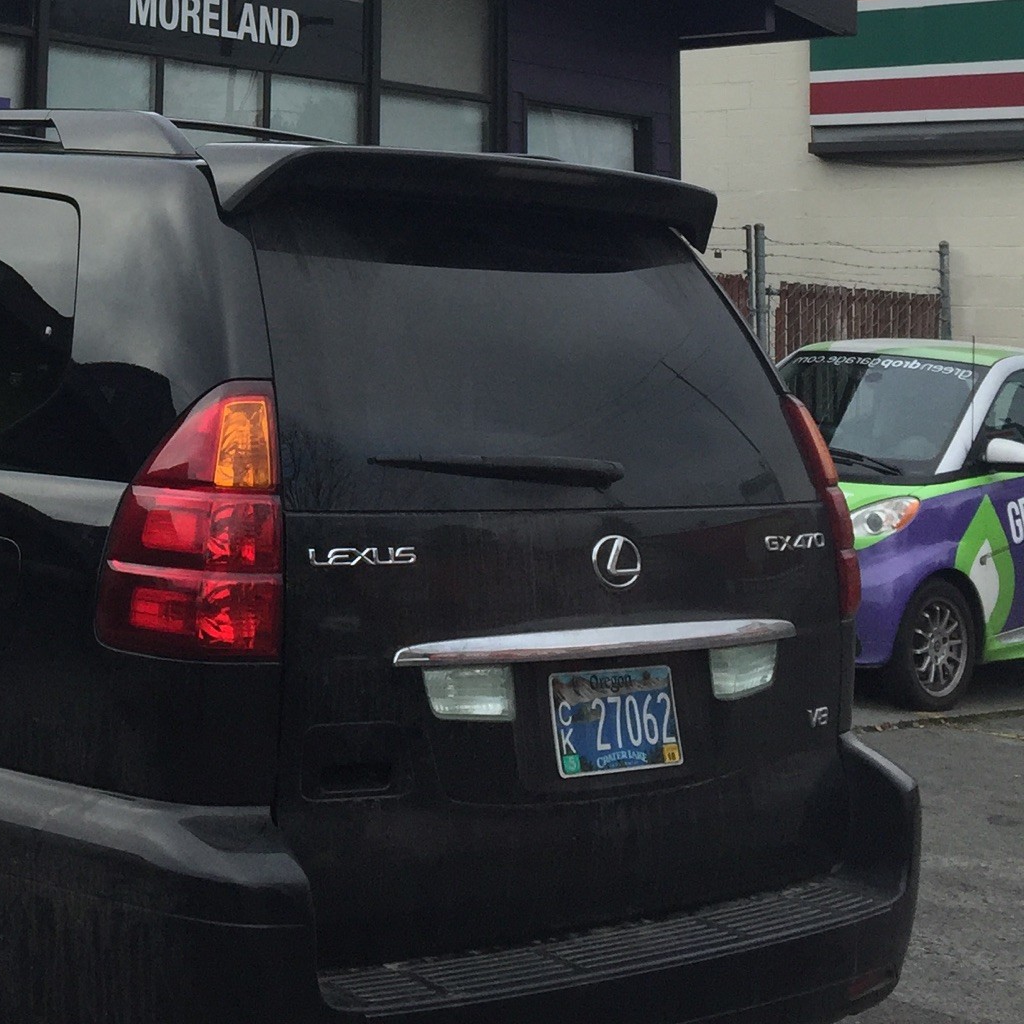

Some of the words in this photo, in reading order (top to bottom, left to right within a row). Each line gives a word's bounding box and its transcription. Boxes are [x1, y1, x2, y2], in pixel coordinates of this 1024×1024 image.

[308, 546, 417, 566] LEXUS
[589, 673, 633, 693] Oregon
[591, 692, 677, 751] 27062
[806, 706, 829, 728] V8
